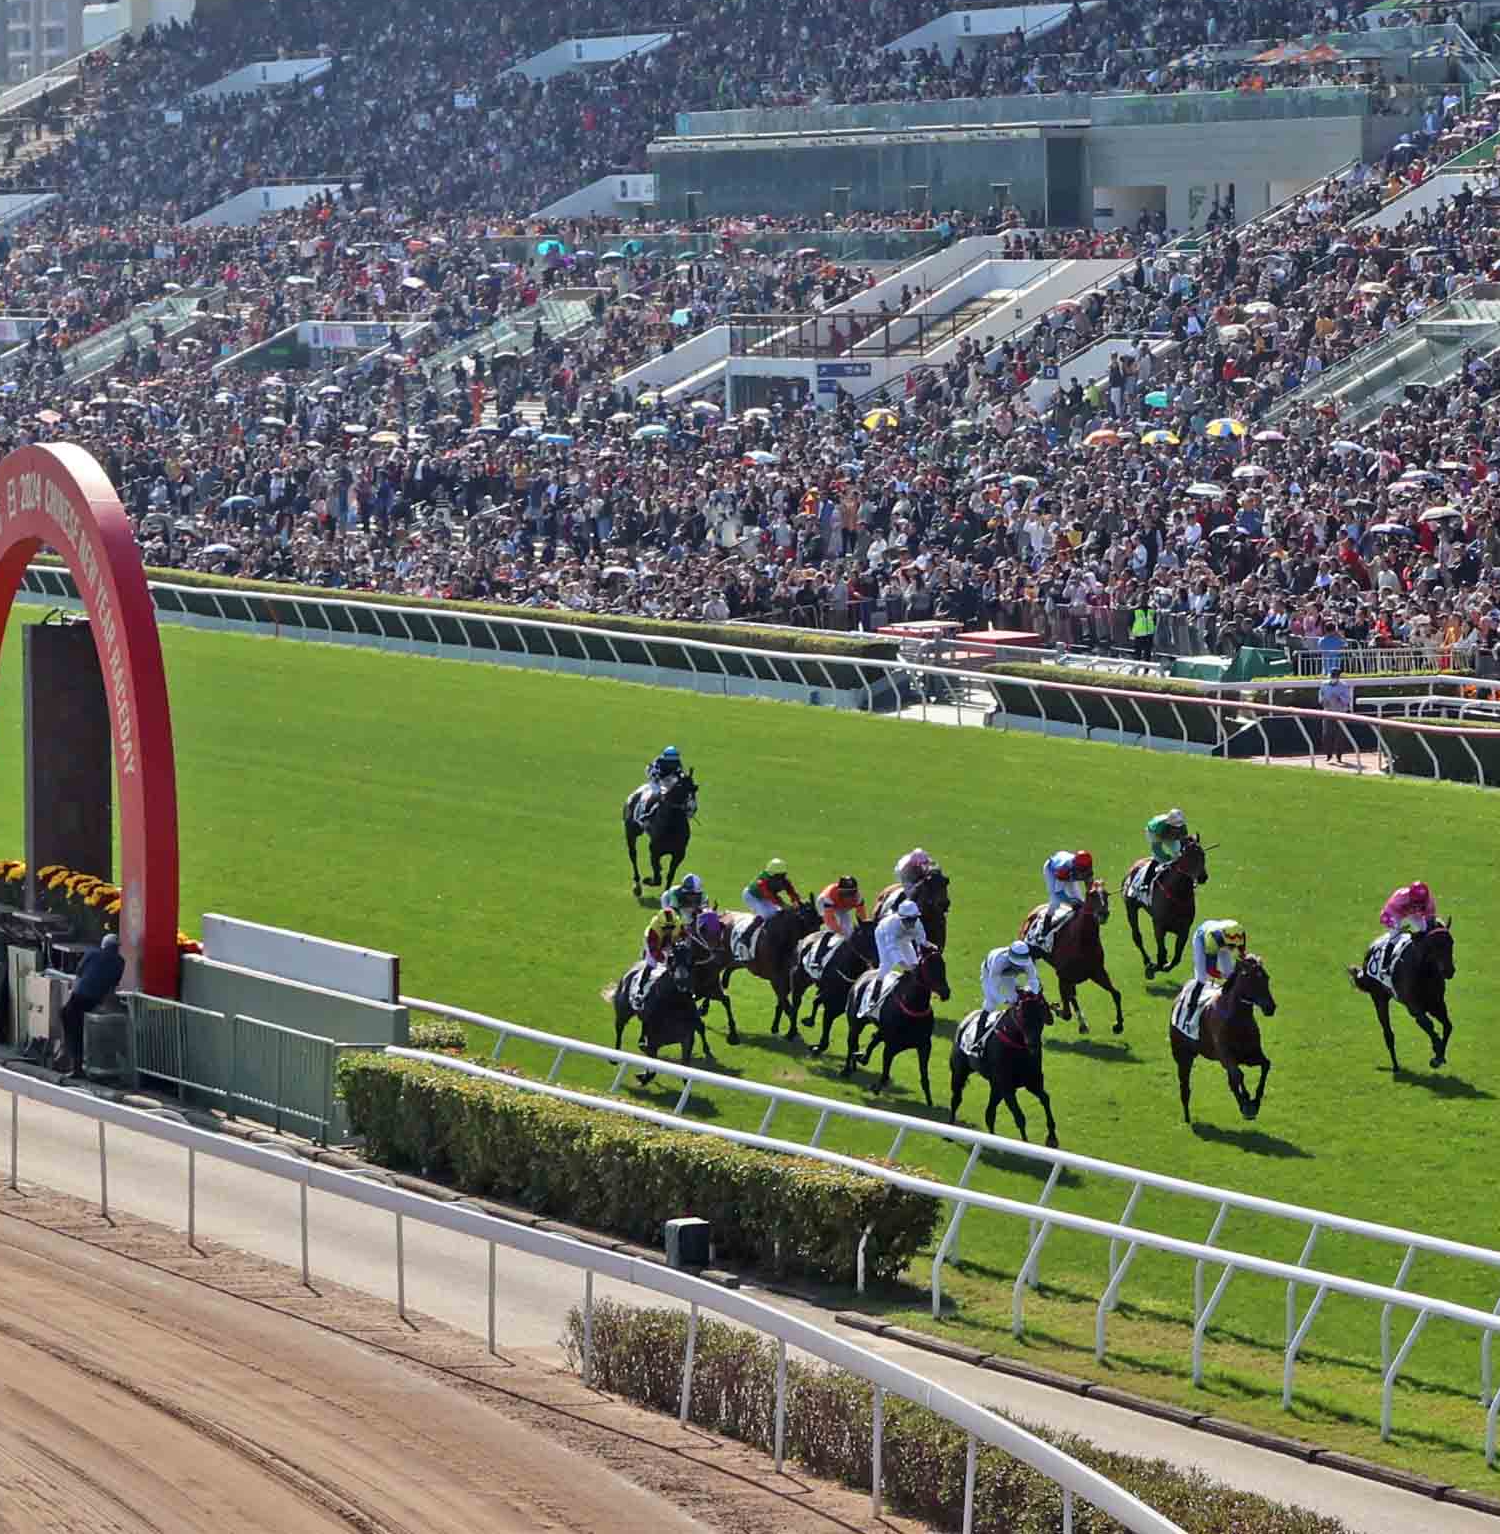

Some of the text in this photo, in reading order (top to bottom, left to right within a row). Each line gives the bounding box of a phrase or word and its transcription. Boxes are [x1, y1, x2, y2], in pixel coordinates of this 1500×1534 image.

[1046, 368, 1055, 377] D
[20, 473, 136, 774] 2024 CHINESE NEW YEAR RACEDAY
[1369, 946, 1382, 975] 8
